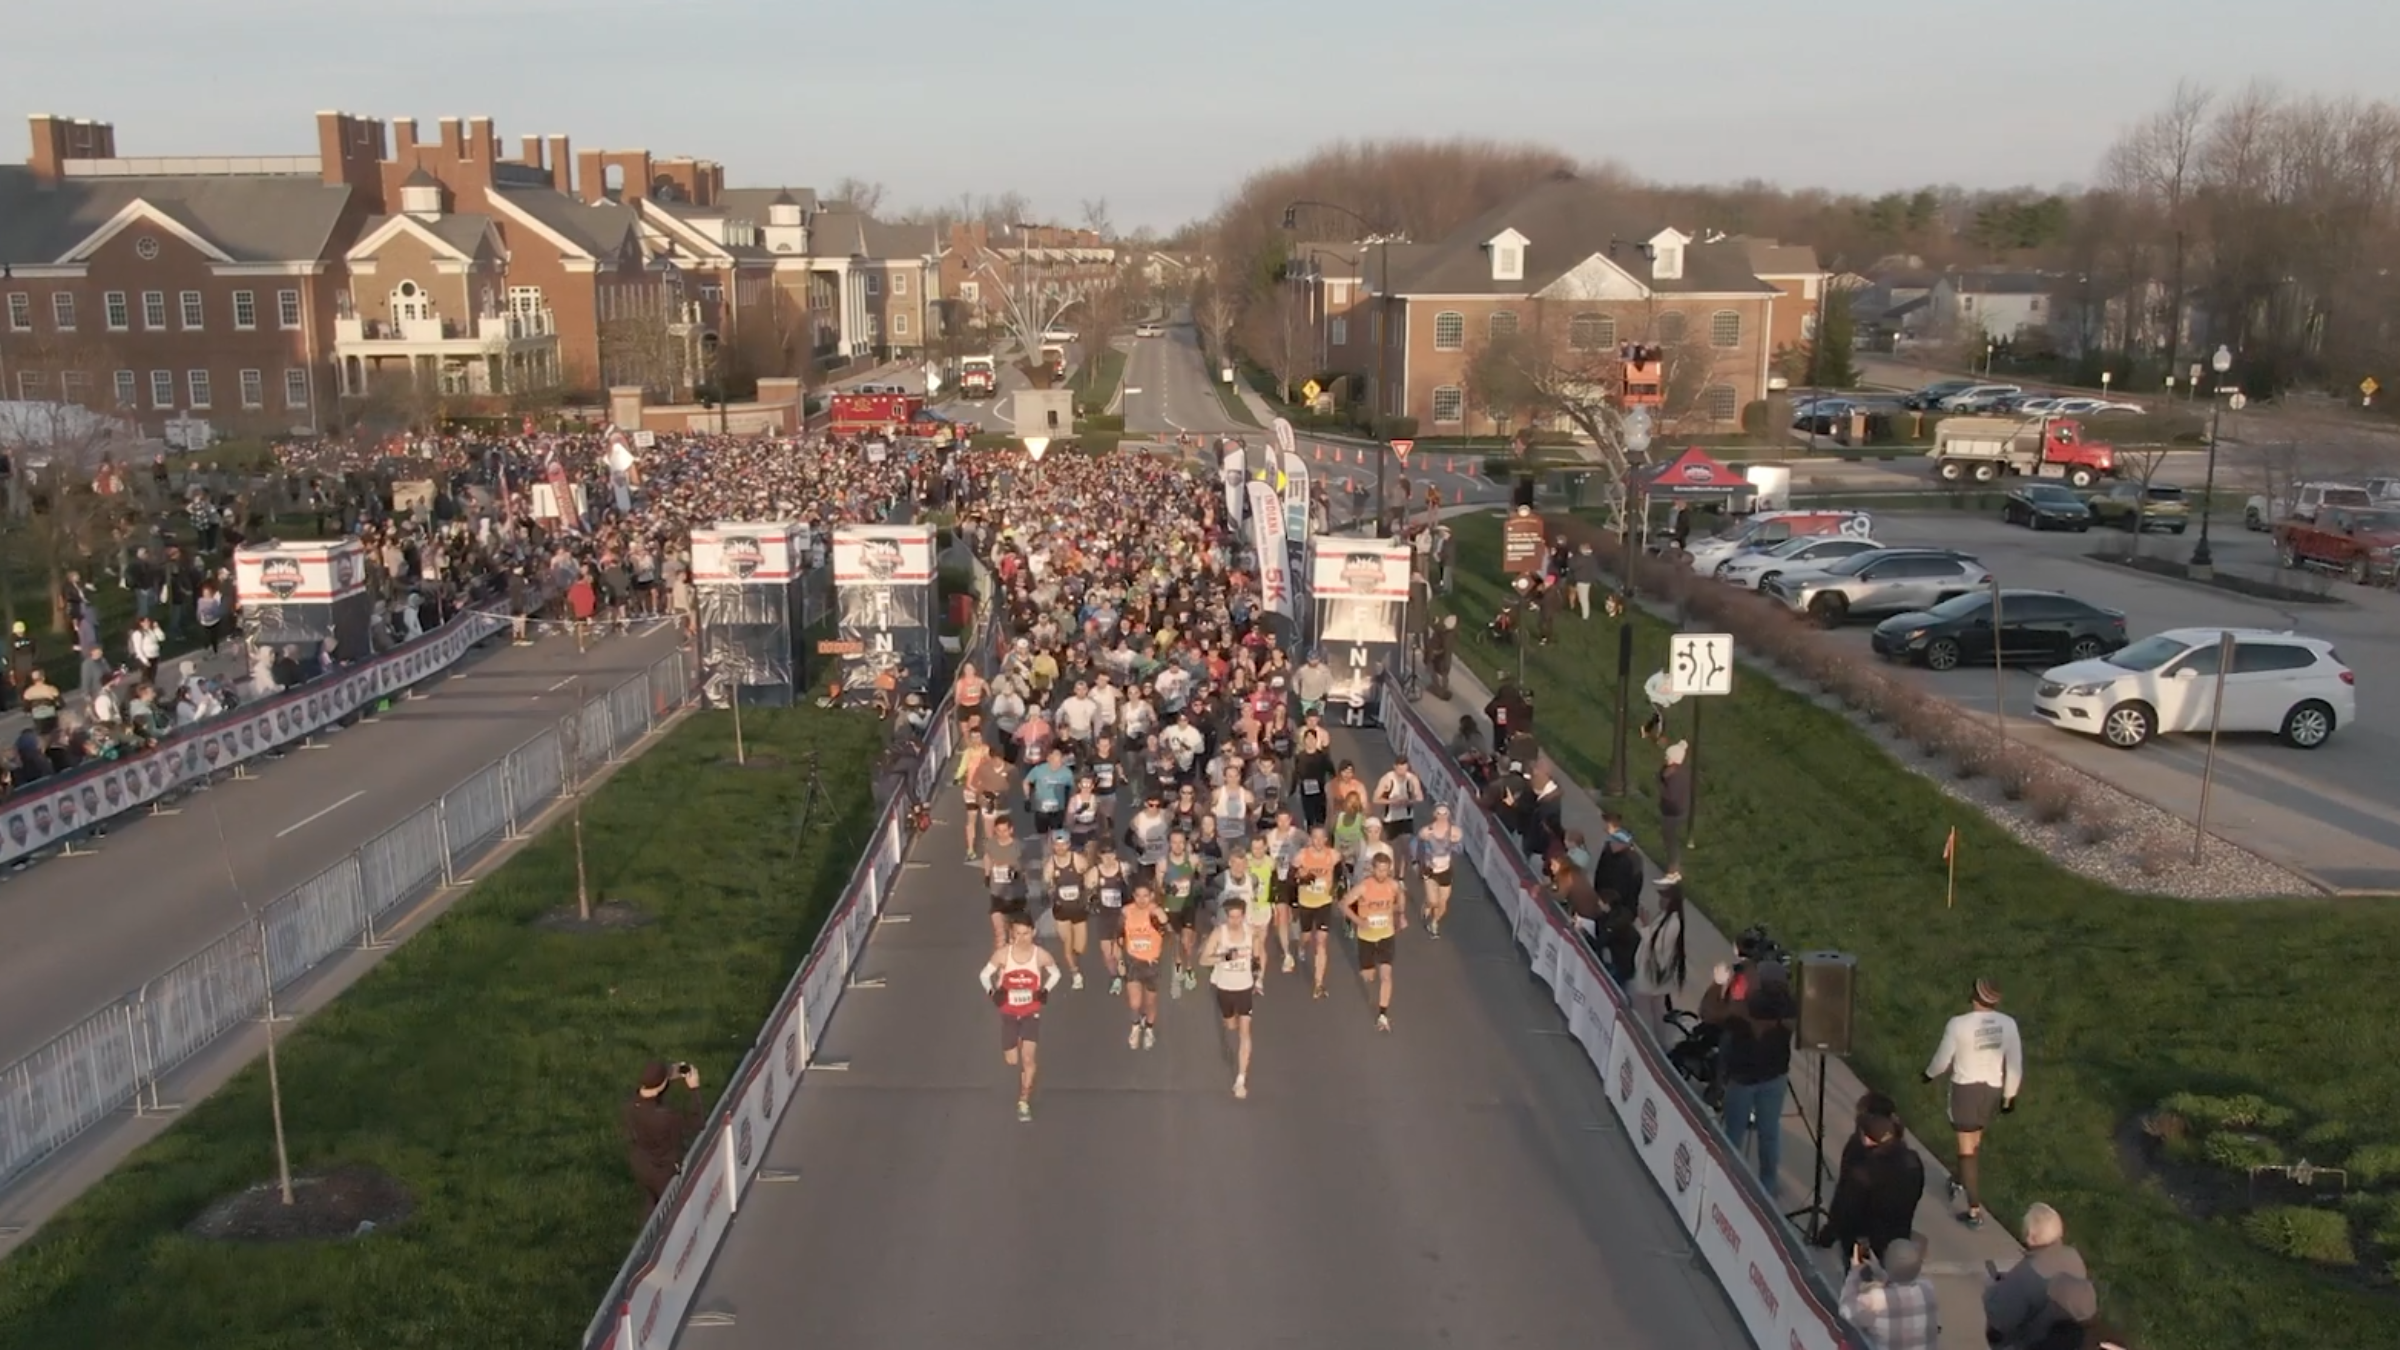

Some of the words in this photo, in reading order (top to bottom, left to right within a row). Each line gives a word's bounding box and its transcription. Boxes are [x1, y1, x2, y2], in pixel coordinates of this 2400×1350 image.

[1264, 494, 1279, 536] INDIANA
[1840, 516, 1871, 540] 59
[1265, 568, 1288, 604] 5K
